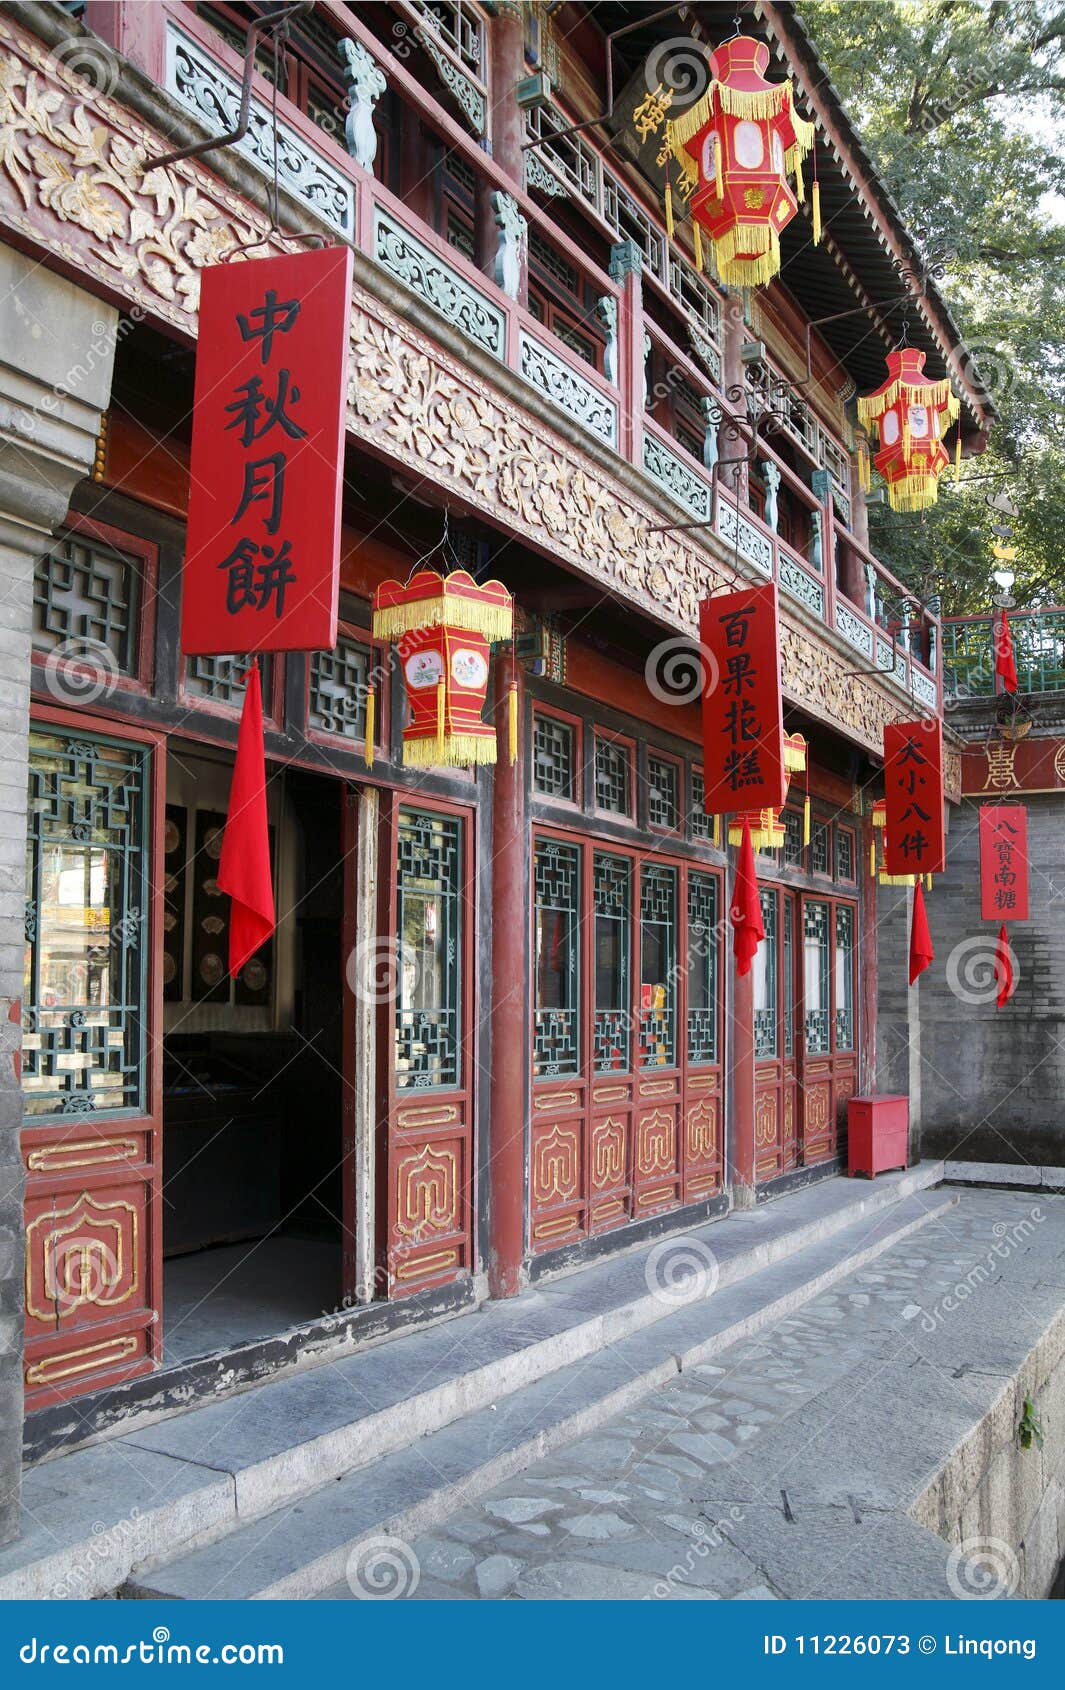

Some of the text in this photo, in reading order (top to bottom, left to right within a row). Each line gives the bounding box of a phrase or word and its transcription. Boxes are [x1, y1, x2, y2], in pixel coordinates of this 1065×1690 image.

[217, 289, 309, 619] 中秋月餅
[718, 606, 764, 791] 百果花糕
[896, 735, 932, 861] 大小八件
[992, 820, 1019, 910] 八寶南糖
